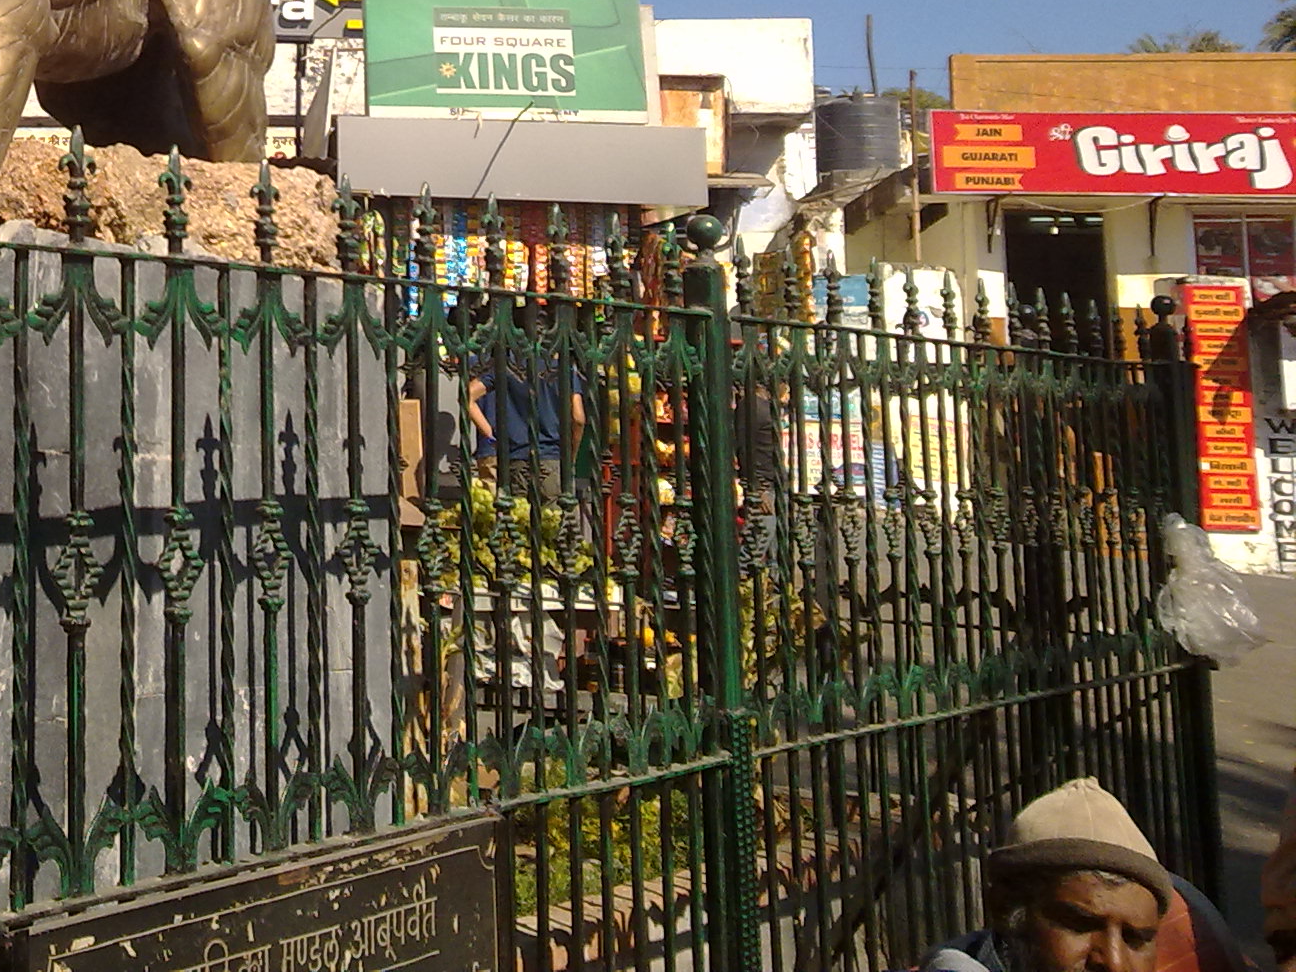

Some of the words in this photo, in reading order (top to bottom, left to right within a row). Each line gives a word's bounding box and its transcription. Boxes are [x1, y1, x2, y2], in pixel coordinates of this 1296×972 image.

[440, 36, 486, 46] FOUR
[494, 37, 567, 48] SQUARE
[452, 52, 576, 93] KINGS
[975, 128, 1002, 137] JAIN
[961, 152, 1019, 162] GUJARATI
[1074, 124, 1294, 190] Giriraj
[965, 176, 1016, 186] PUNJABI
